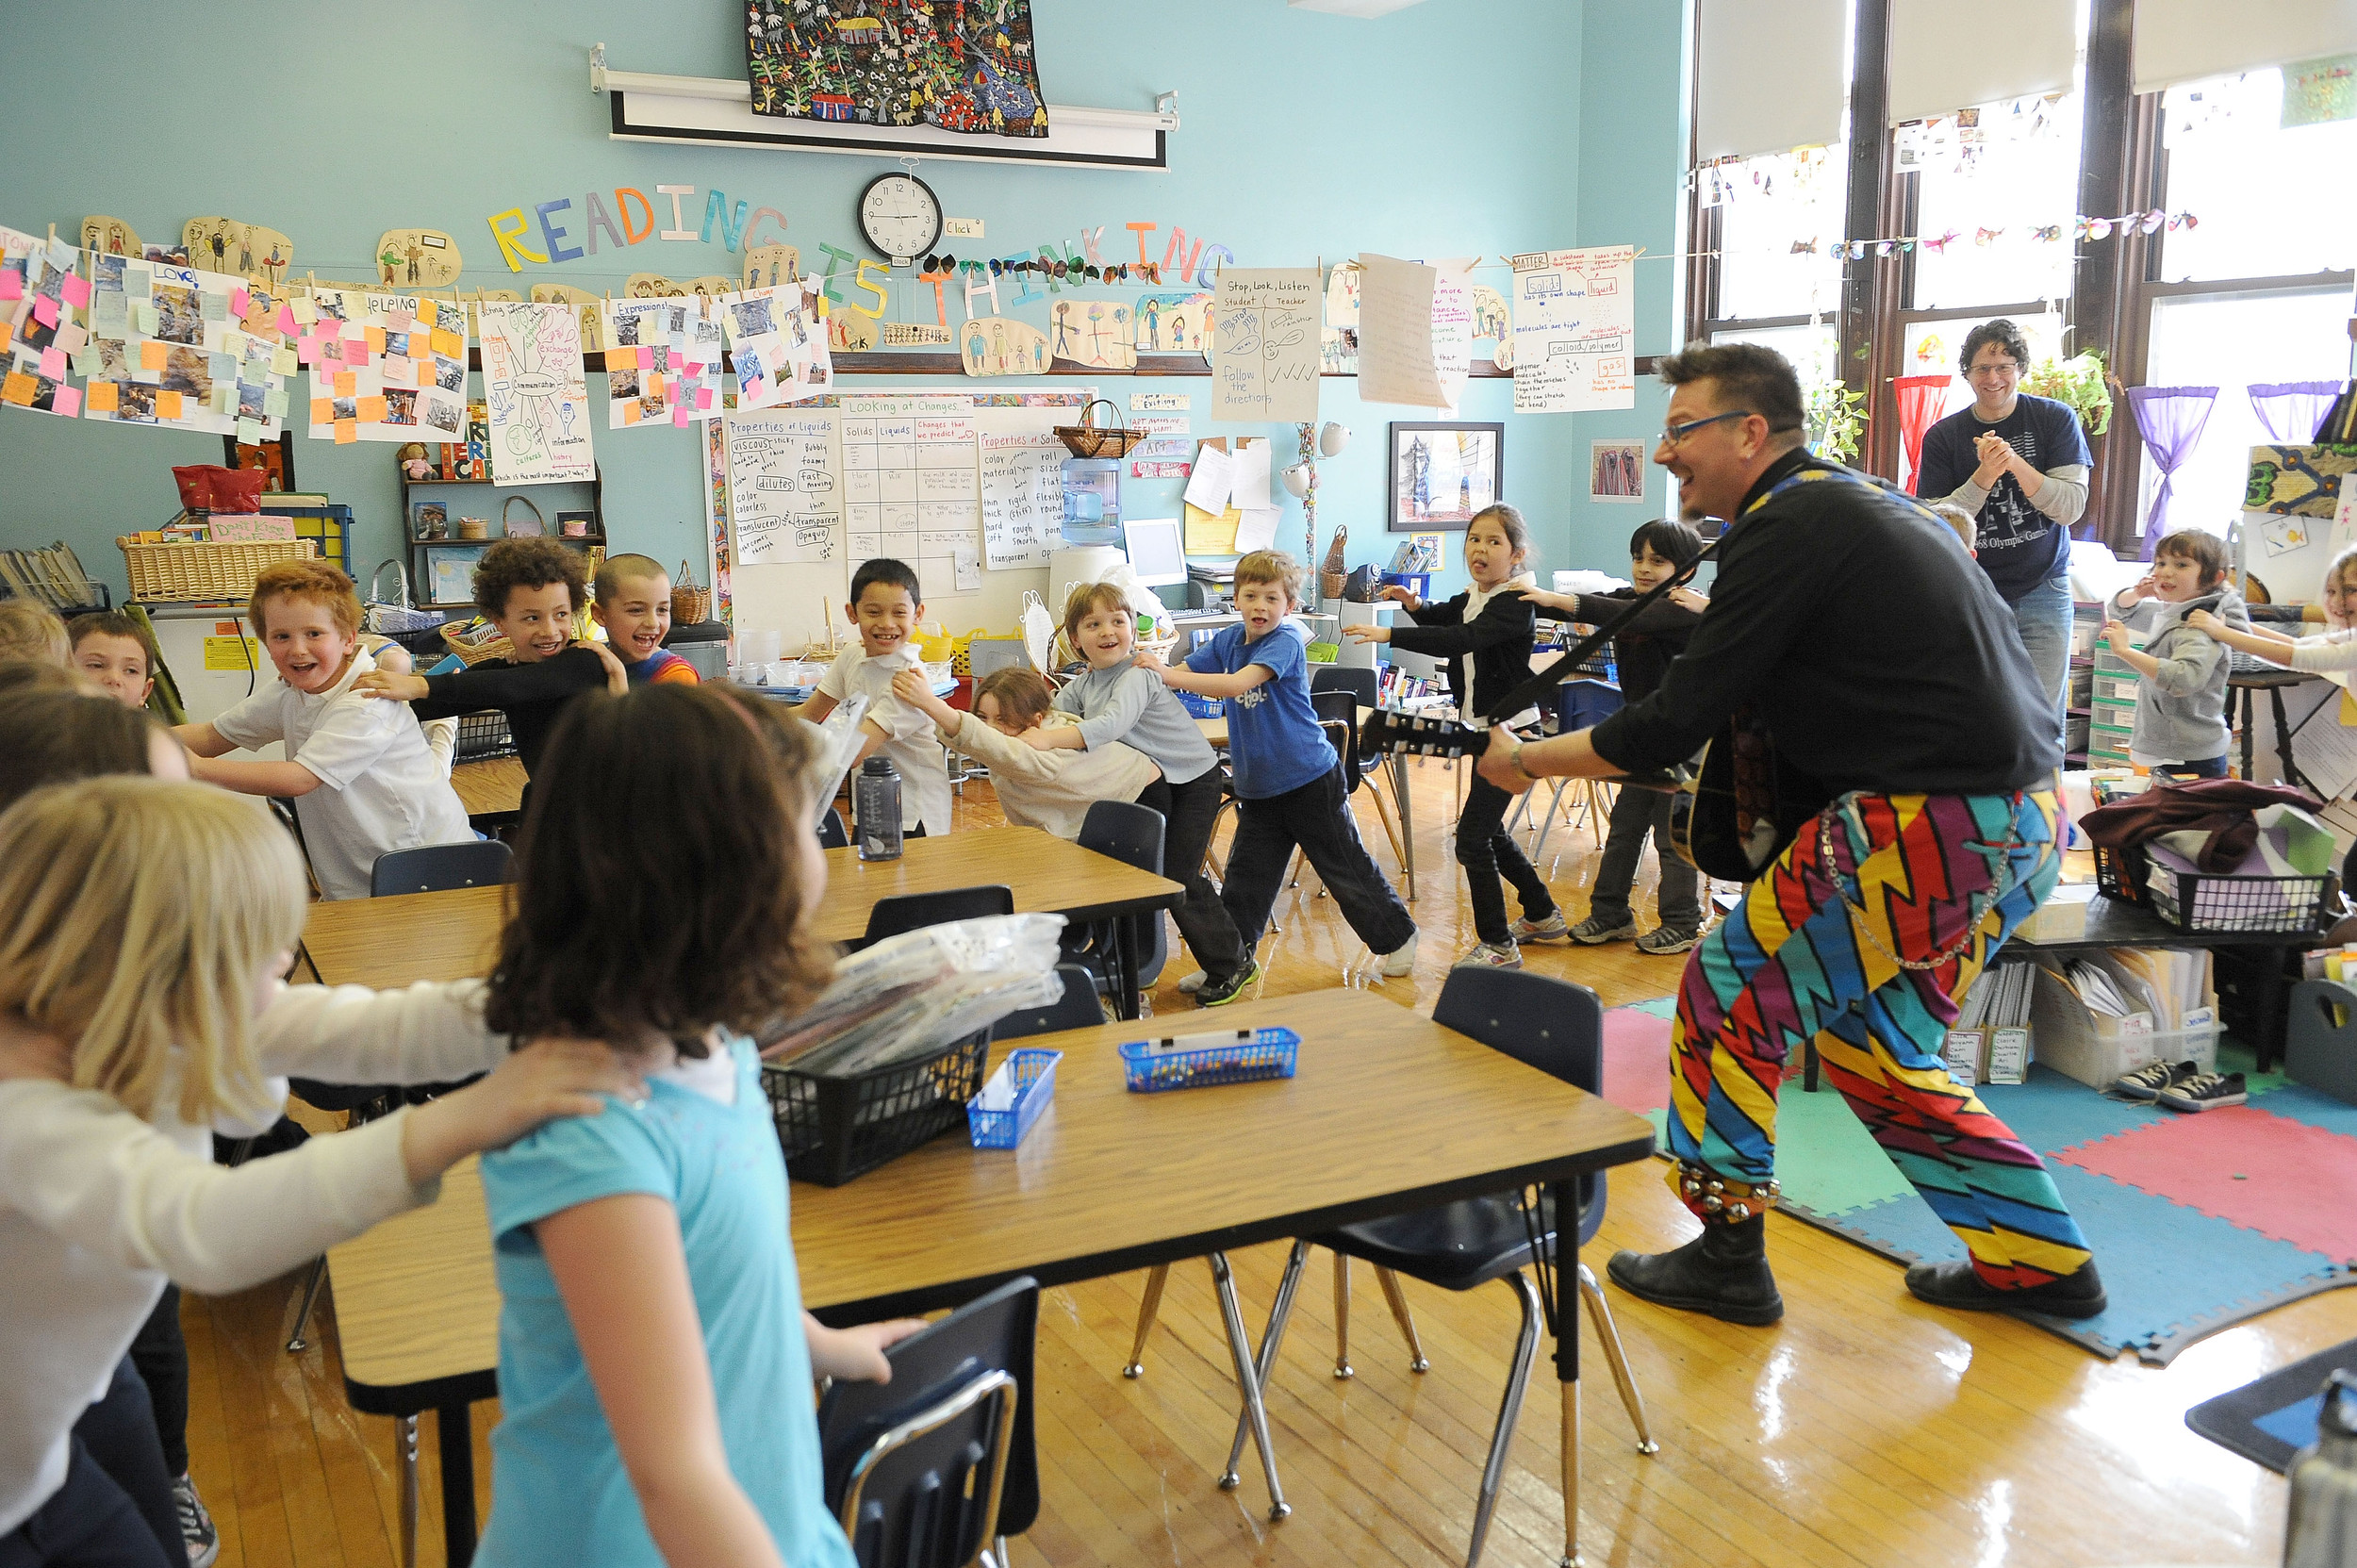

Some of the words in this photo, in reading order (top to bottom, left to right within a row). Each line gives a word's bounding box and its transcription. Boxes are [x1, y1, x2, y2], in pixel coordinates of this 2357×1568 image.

[896, 184, 904, 193] 12
[920, 200, 926, 208] 2
[487, 184, 788, 272] READING
[872, 226, 878, 235] 8
[947, 222, 971, 234] Clock
[920, 229, 926, 238] 4
[885, 239, 890, 247] 7
[898, 242, 903, 251] 6
[1513, 256, 1543, 269] MATTER
[818, 241, 890, 320] IS
[919, 222, 1234, 326] THINKING
[1278, 281, 1310, 291] Listen
[1566, 289, 1586, 299] shape
[1225, 296, 1256, 305] Student
[618, 301, 668, 317] Expressions!
[1233, 308, 1247, 323] STOP
[539, 346, 573, 358] exchange
[514, 379, 555, 388] Communication
[1232, 383, 1246, 391] the
[1225, 393, 1271, 404] directions
[902, 401, 913, 410] at
[731, 421, 783, 434] Properties
[917, 421, 947, 430] Changes
[846, 427, 873, 437] Solids
[880, 426, 911, 437] Liquids
[930, 430, 955, 440] predict
[552, 437, 585, 446] information
[773, 437, 794, 448] sticky
[981, 434, 1027, 448] Properties
[553, 454, 572, 462] history
[985, 454, 1005, 464] color
[1041, 452, 1057, 460] roll
[801, 456, 826, 469] foamy
[800, 472, 820, 482] fast
[983, 466, 1017, 478] material
[759, 477, 792, 490] dilutes
[807, 481, 832, 490] moving
[1043, 477, 1059, 487] flat
[736, 491, 757, 503] color
[1008, 492, 1027, 508] rigid
[810, 502, 826, 511] thin
[983, 499, 997, 507] thin
[1040, 503, 1063, 513] round
[736, 503, 767, 514] colorless
[984, 509, 1002, 518] thick
[736, 519, 779, 533] translucent
[796, 515, 839, 527] transparent
[985, 521, 1002, 532] hard
[1013, 523, 1032, 536] rough
[987, 534, 1002, 543] soft
[1989, 536, 2024, 549] Olympic
[2025, 529, 2049, 541] Games
[991, 553, 1030, 564] transparent
